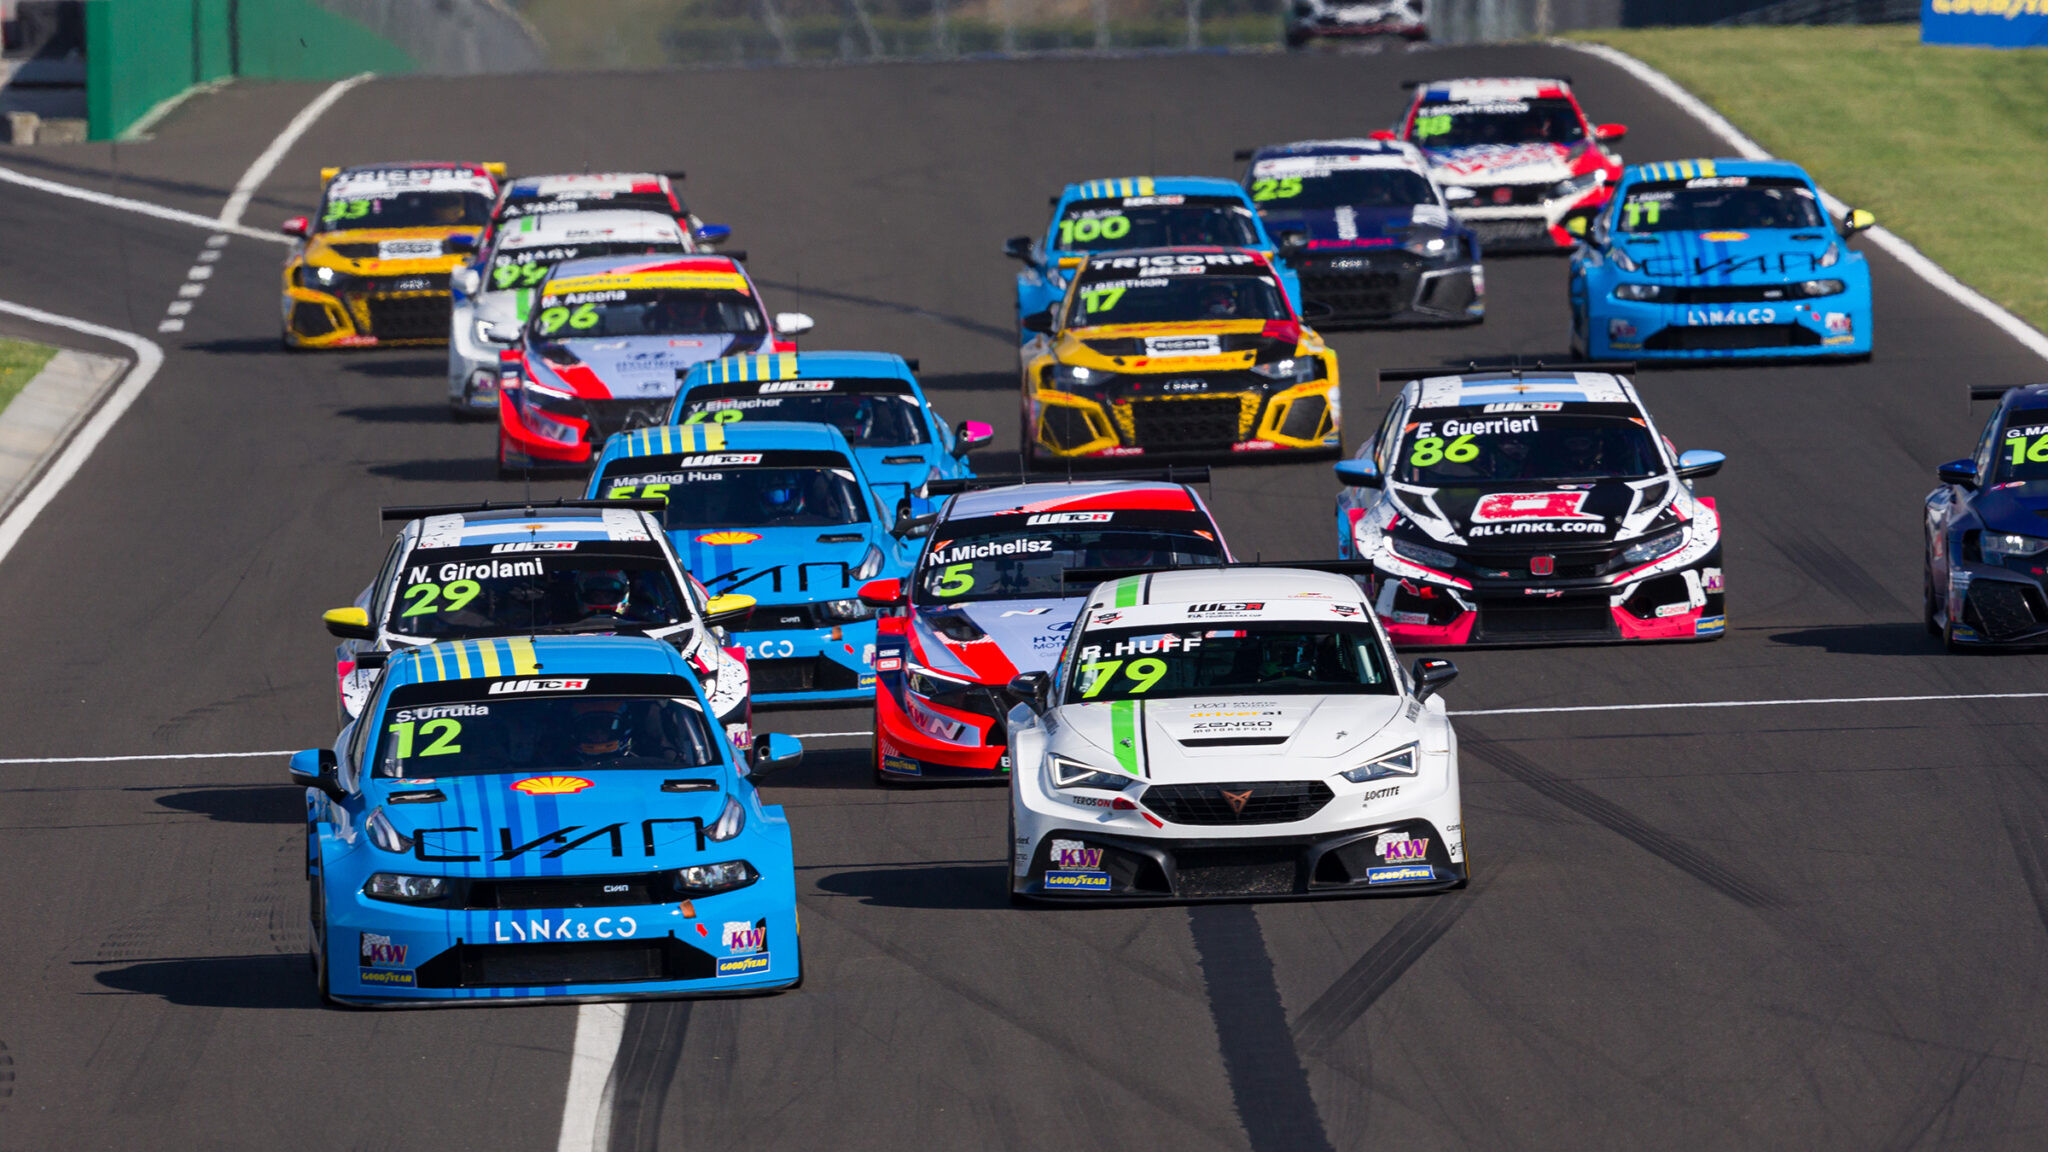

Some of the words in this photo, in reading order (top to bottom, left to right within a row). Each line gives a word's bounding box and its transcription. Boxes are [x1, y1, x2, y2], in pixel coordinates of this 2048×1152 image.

[1252, 177, 1303, 202] 25
[322, 200, 370, 222] 33
[1624, 201, 1659, 227] 11
[1060, 215, 1131, 244] 100
[1090, 254, 1254, 270] TRICORP
[1081, 287, 1127, 313] 17
[540, 303, 599, 333] 96
[1416, 422, 1437, 438] E.
[1442, 415, 1539, 437] Guerrieri
[1410, 434, 1480, 467] 86
[2005, 434, 2048, 465] 16
[688, 471, 723, 481] Hua
[929, 539, 1053, 566] N.Michelisz
[408, 566, 431, 584] N.
[439, 558, 544, 582] Girolami
[939, 563, 974, 597] 5
[401, 579, 481, 618] 29
[1081, 638, 1203, 661] R.HUFF
[488, 678, 590, 694] WTCR
[1081, 657, 1168, 699] 79
[396, 704, 489, 723] S.Urrutia
[389, 718, 462, 759] 12
[1073, 796, 1110, 807] TEROSON
[1364, 786, 1400, 801] LOCTITE
[1059, 848, 1104, 867] KW
[1384, 838, 1429, 860] KW
[1050, 875, 1107, 886] GOODYEAR
[1371, 869, 1429, 880] GOODYEAR
[731, 926, 766, 950] KW
[371, 944, 408, 965] KW
[720, 957, 767, 971] GOODYEAR
[362, 972, 412, 983] GOODYEAR
